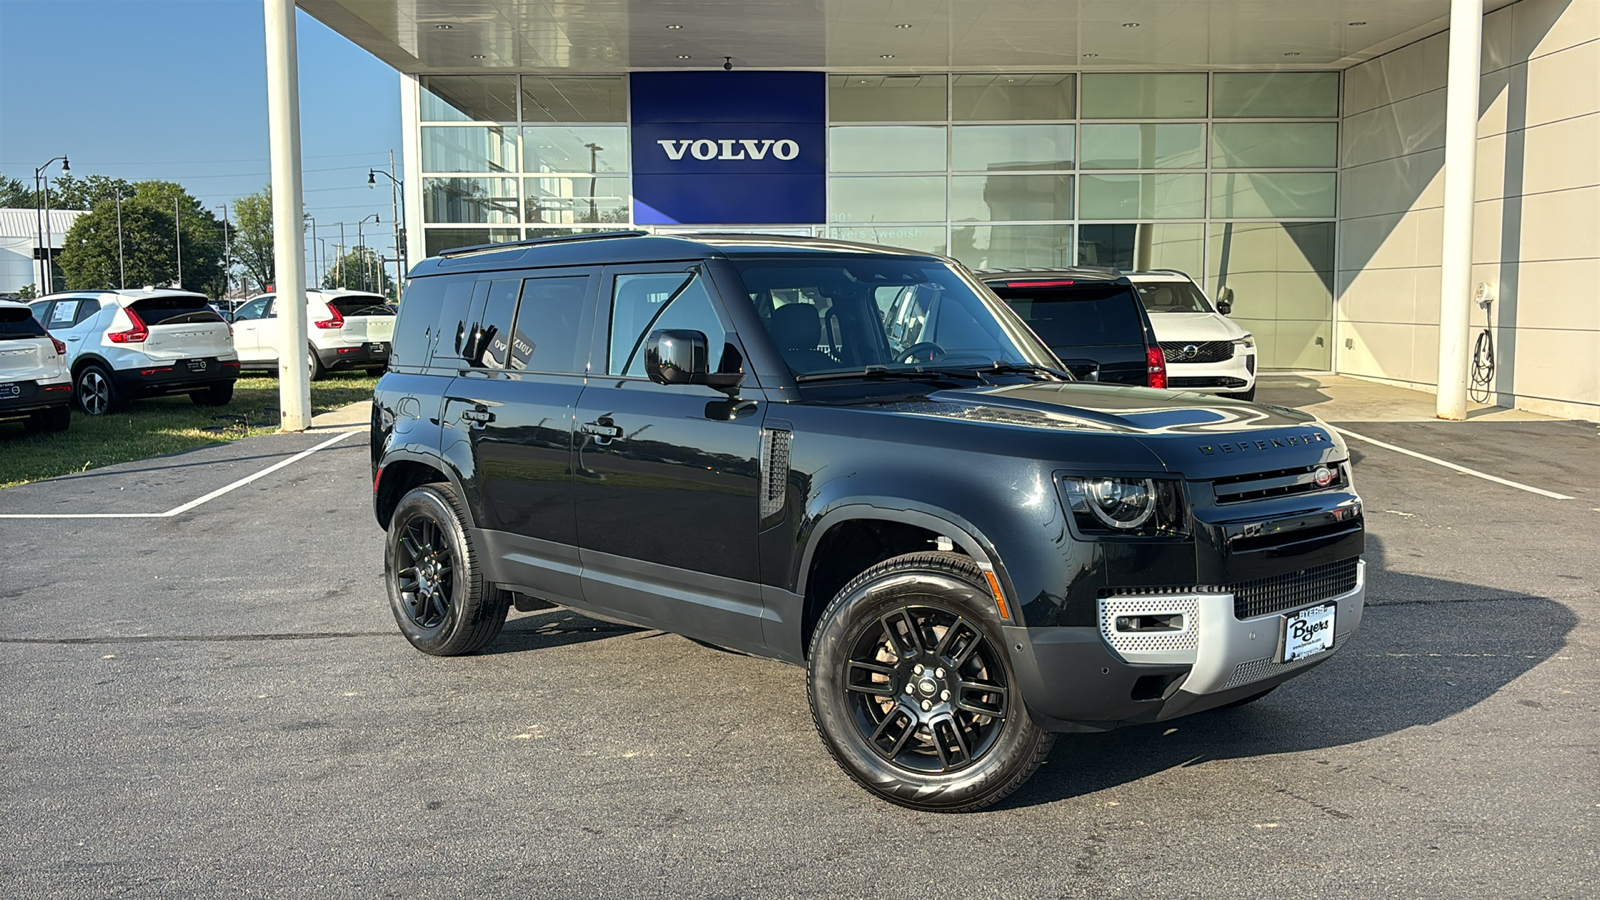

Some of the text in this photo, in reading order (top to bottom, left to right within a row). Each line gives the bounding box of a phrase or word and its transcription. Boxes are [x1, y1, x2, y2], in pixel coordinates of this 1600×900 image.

[657, 138, 800, 161] VOLVO
[831, 227, 922, 240] Byers Swedish
[1198, 432, 1327, 456] DEFENDER
[1289, 619, 1329, 642] Byers
